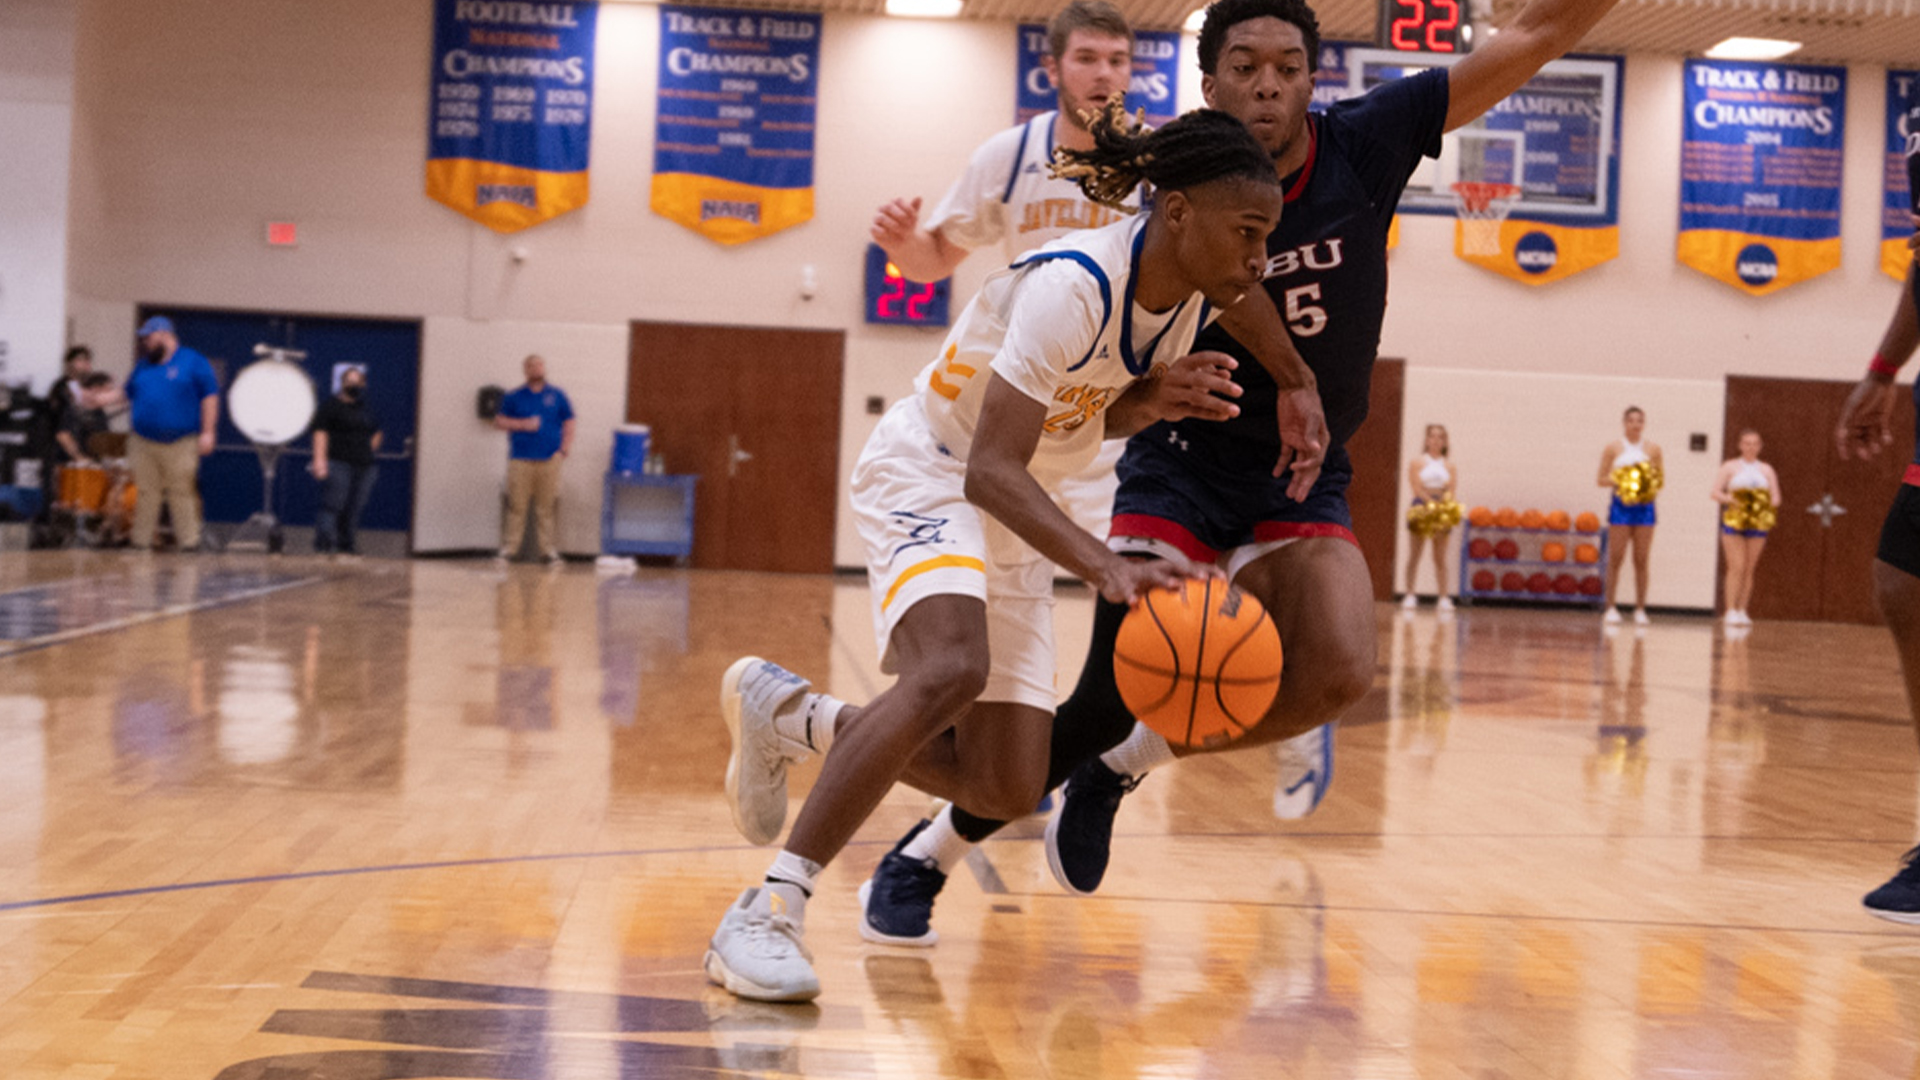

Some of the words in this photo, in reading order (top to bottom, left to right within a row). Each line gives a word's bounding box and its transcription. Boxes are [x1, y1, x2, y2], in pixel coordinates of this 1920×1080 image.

[455, 1, 579, 27] FOOTBALL
[666, 12, 733, 35] TRACK
[738, 16, 755, 37] &
[760, 18, 815, 39] FIELD
[1391, 0, 1459, 52] 22
[443, 49, 585, 86] CHAMPIONS
[667, 47, 809, 83] CHAMPIONS
[1692, 65, 1760, 89] TRACK
[1762, 68, 1781, 90] &
[1785, 70, 1840, 92] FIELD
[1694, 100, 1833, 135] CHAMPIONS
[701, 198, 760, 226] NAIA
[1258, 237, 1343, 280] BU
[876, 274, 935, 320] 22
[1284, 281, 1328, 337] 5
